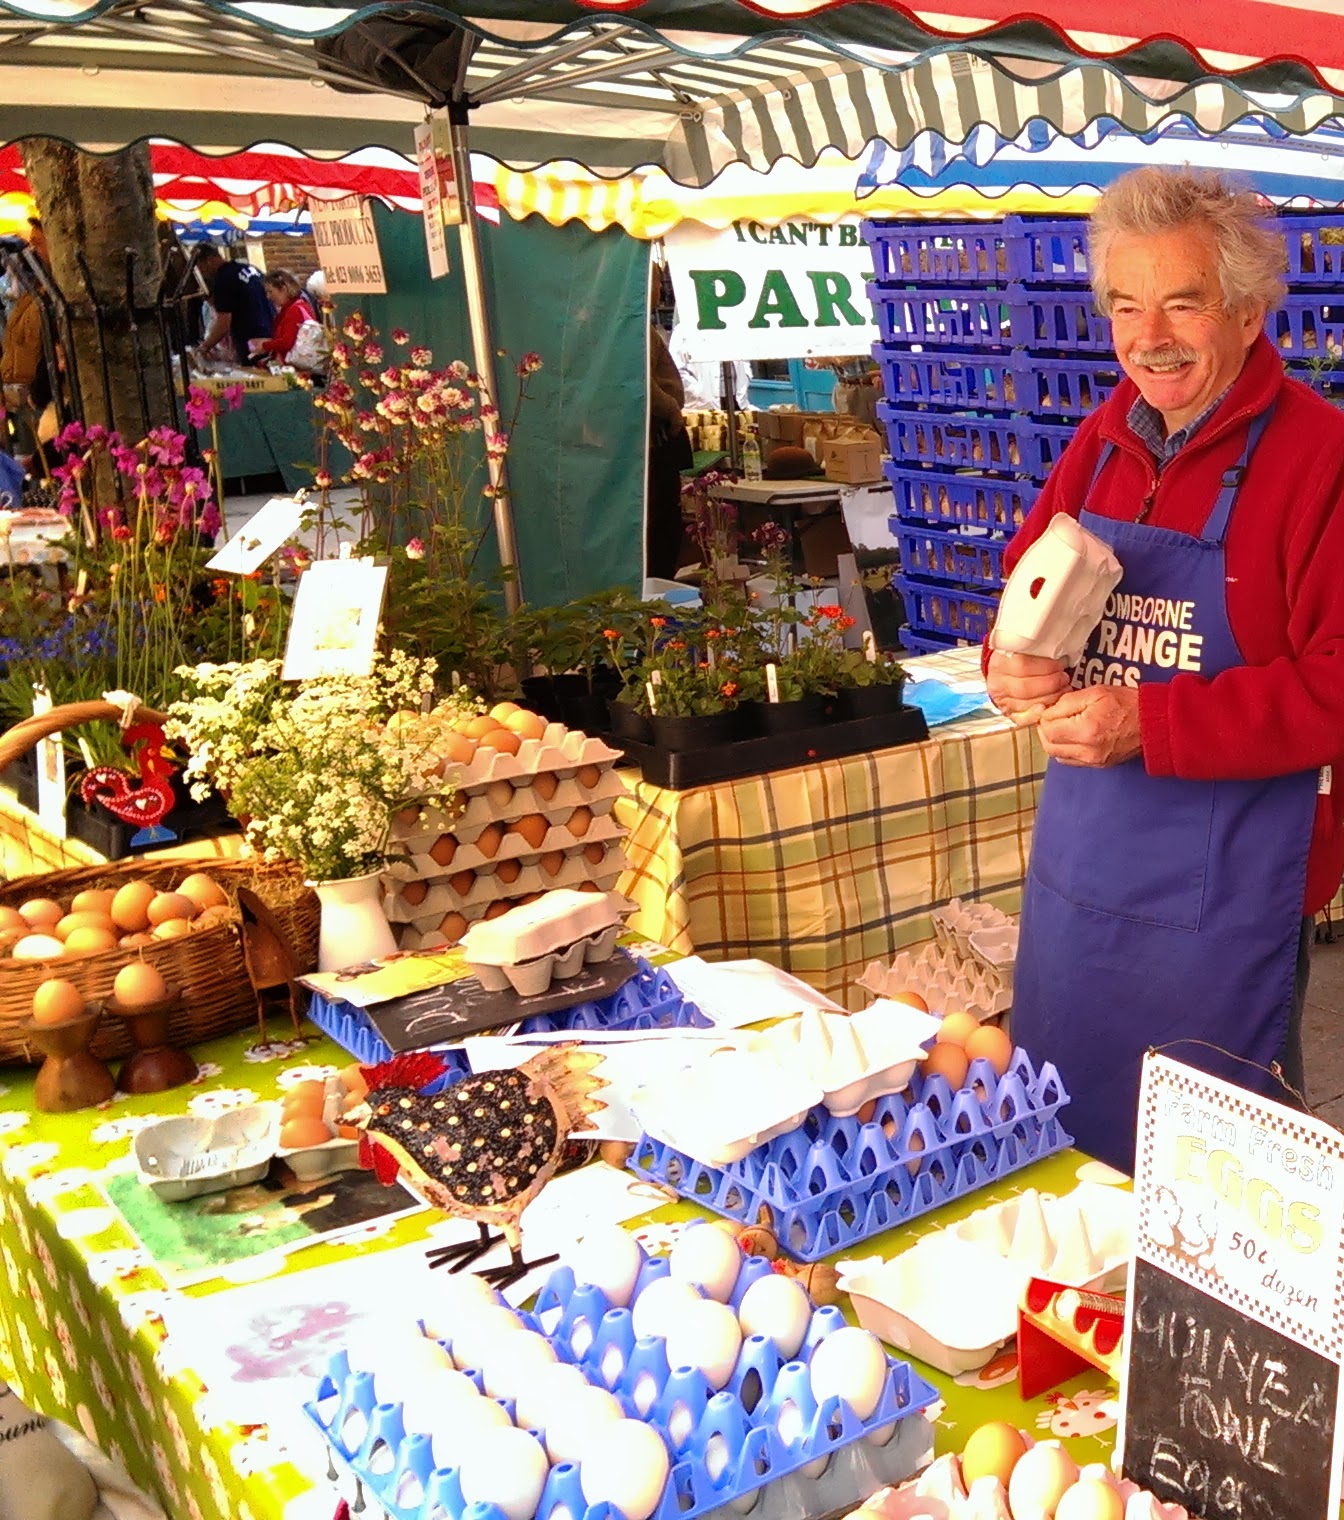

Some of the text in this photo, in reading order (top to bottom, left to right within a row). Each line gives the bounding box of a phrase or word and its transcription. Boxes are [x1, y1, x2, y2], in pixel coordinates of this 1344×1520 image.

[329, 216, 375, 246] PRODUCTS
[732, 220, 748, 243] I
[747, 220, 834, 248] CAN'T
[689, 269, 880, 330] PAR
[1101, 592, 1196, 631] OMBORNE
[1097, 620, 1204, 672] RANGE
[1163, 1086, 1335, 1192] Farm Fresh
[1174, 1134, 1324, 1255] EGGS
[1259, 1268, 1319, 1313] dozen
